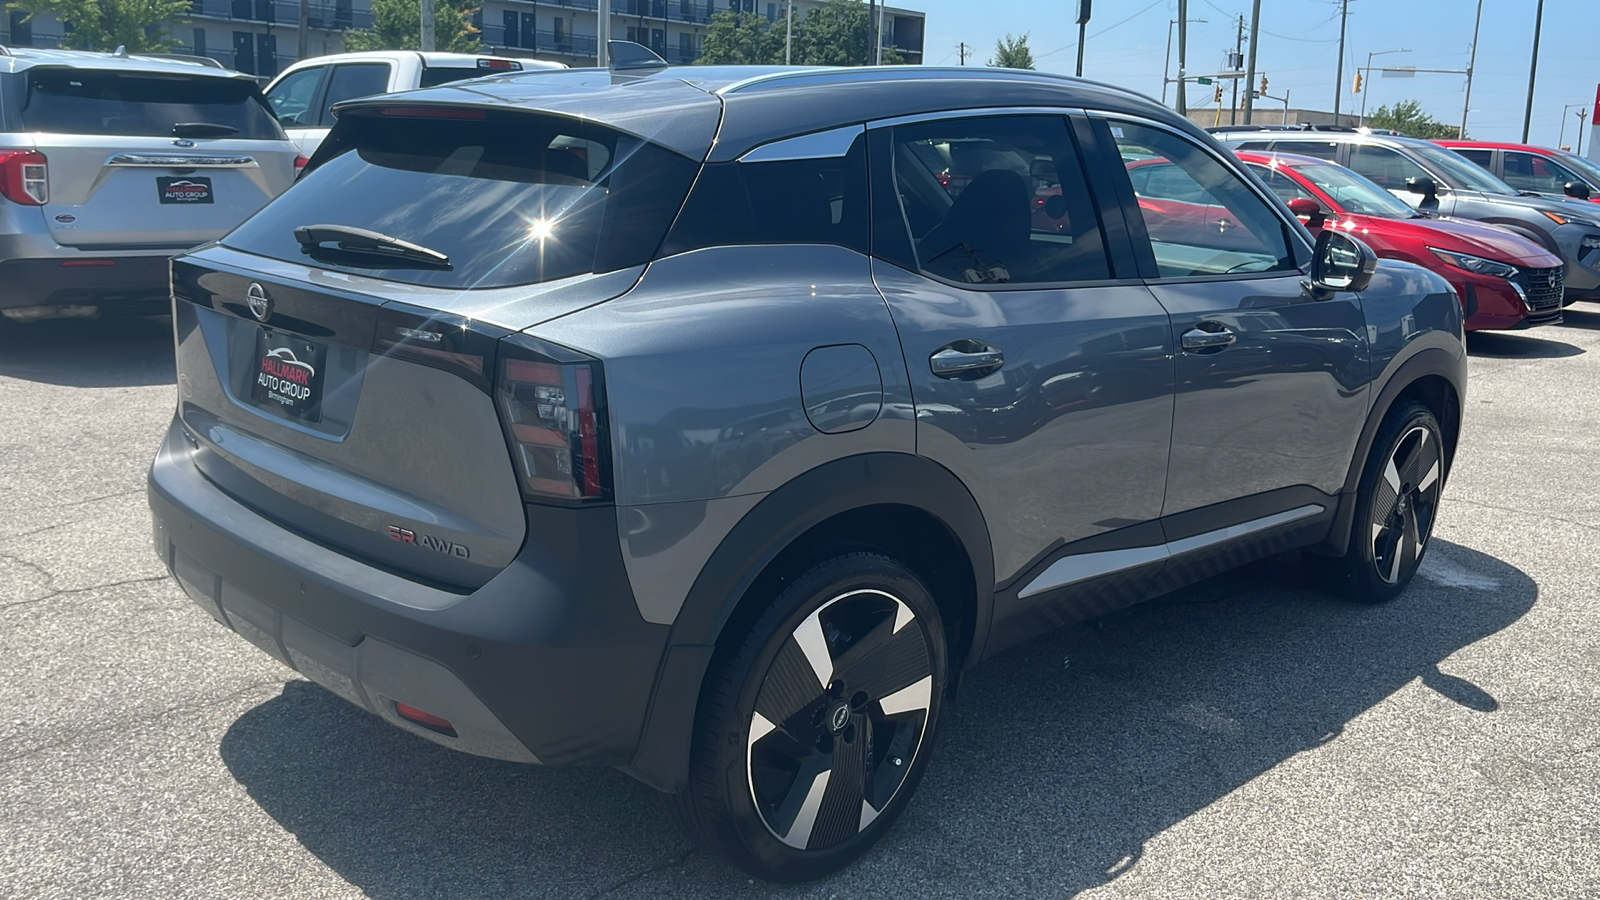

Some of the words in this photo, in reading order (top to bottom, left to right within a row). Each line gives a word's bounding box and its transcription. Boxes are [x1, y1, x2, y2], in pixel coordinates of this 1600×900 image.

[262, 357, 310, 386] HALLMARK
[258, 374, 279, 390] AUTO
[280, 380, 310, 401] GROUP
[268, 390, 294, 407] Birmingham
[422, 535, 470, 559] AWD
